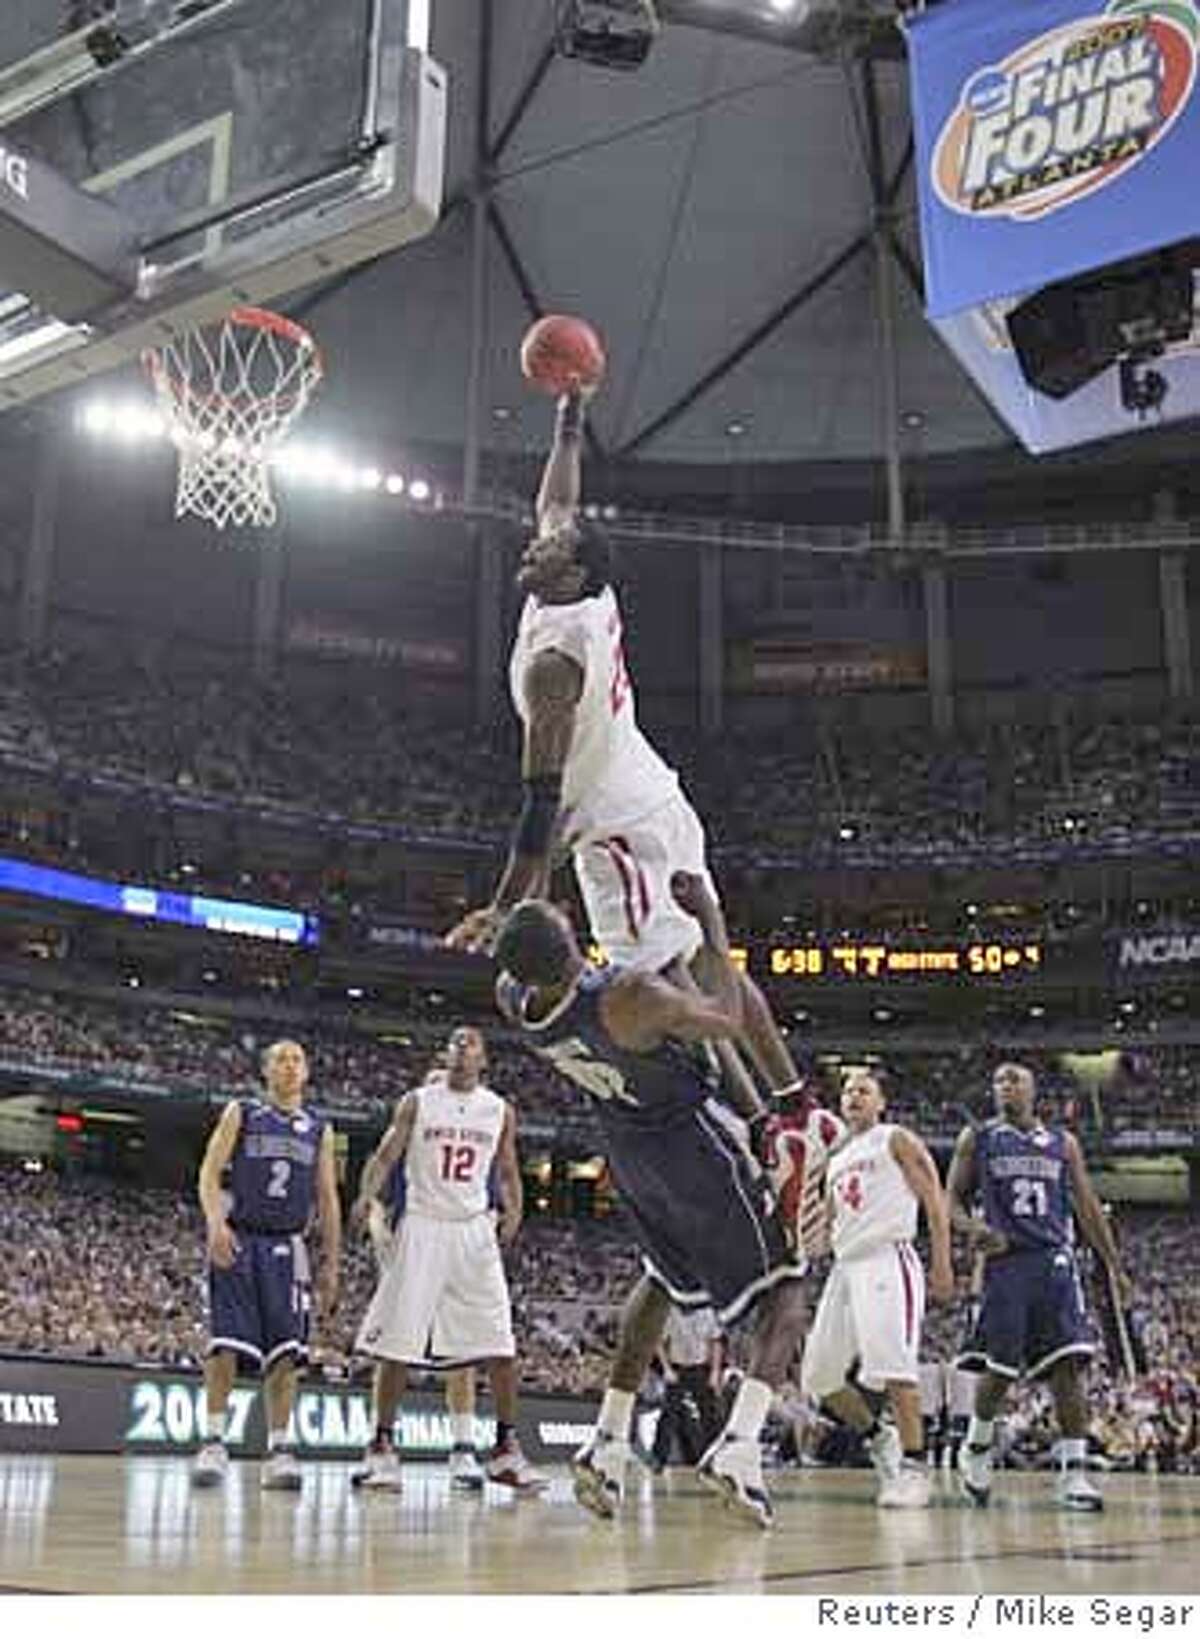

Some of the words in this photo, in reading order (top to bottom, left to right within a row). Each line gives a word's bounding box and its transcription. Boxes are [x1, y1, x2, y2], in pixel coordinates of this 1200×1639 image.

[1014, 37, 1152, 117] FINAL
[963, 78, 1156, 192] FOUR
[971, 137, 1141, 208] ATLANTA
[266, 1160, 290, 1198] 2
[442, 1145, 476, 1181] 12
[1013, 1178, 1046, 1216] 21
